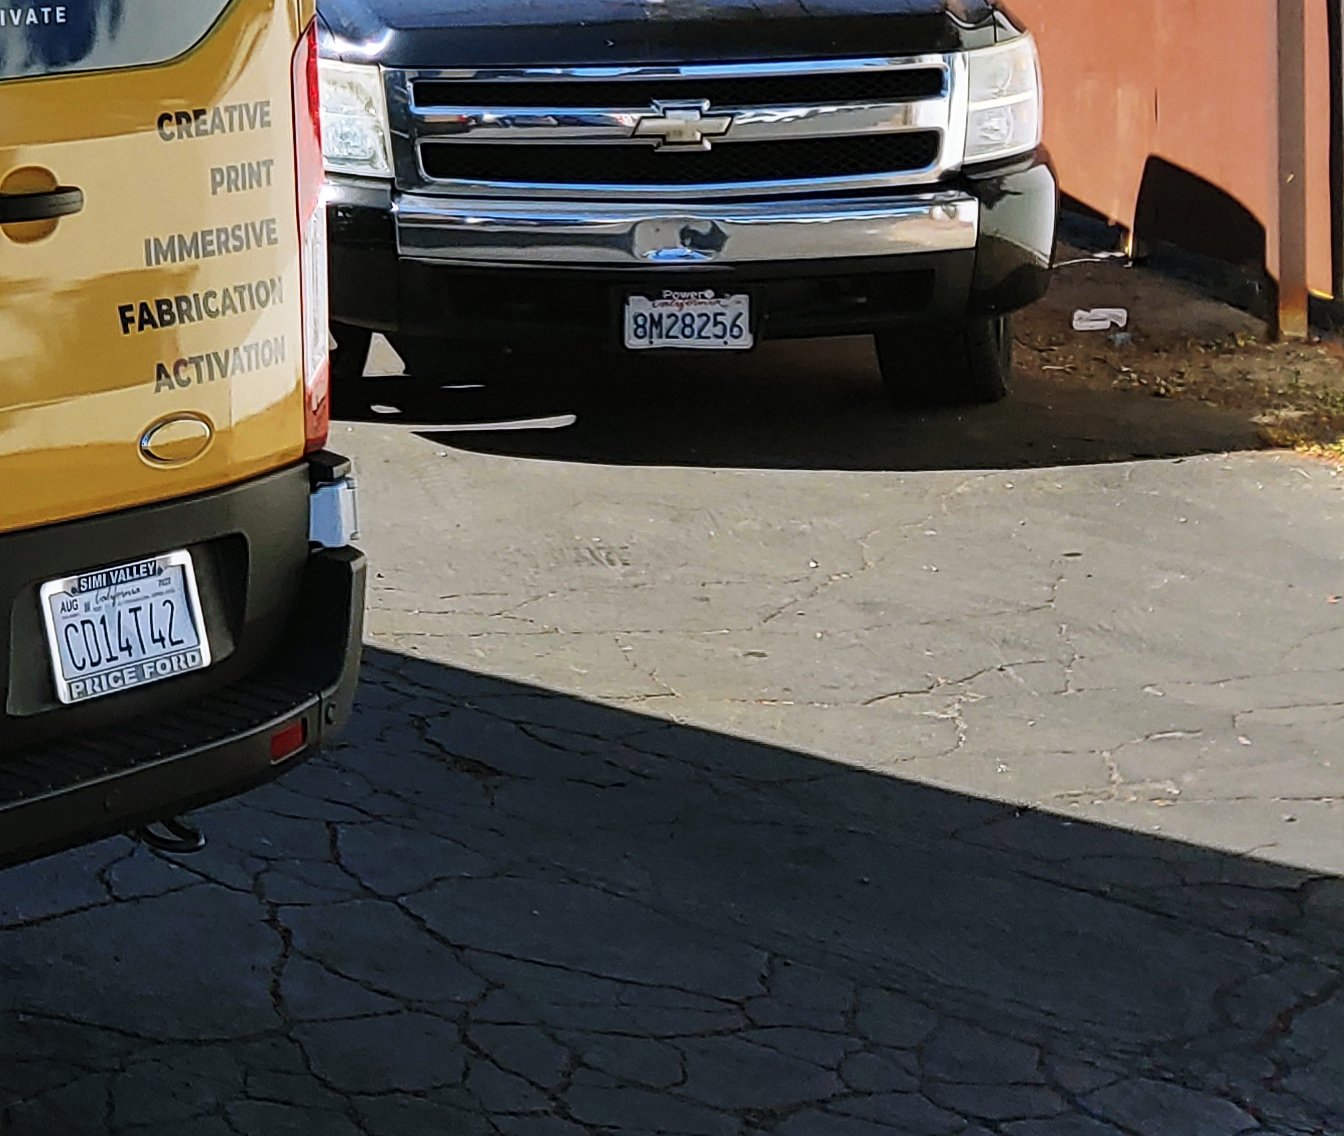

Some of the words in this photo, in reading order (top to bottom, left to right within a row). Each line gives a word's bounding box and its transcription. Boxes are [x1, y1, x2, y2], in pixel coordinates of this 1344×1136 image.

[156, 100, 272, 141] CREATIVE
[210, 159, 274, 196] PRINT
[144, 218, 279, 267] IMMERSIVE
[118, 276, 284, 335] FABRICATION
[633, 311, 744, 340] 8M28256
[154, 335, 286, 393] ACTIVATION
[80, 573, 107, 592] SIMI
[110, 561, 156, 584] VALLEY
[59, 598, 79, 614] AUG
[64, 599, 185, 671] CD14T42
[70, 666, 139, 700] PRICE
[142, 651, 202, 679] FORD
